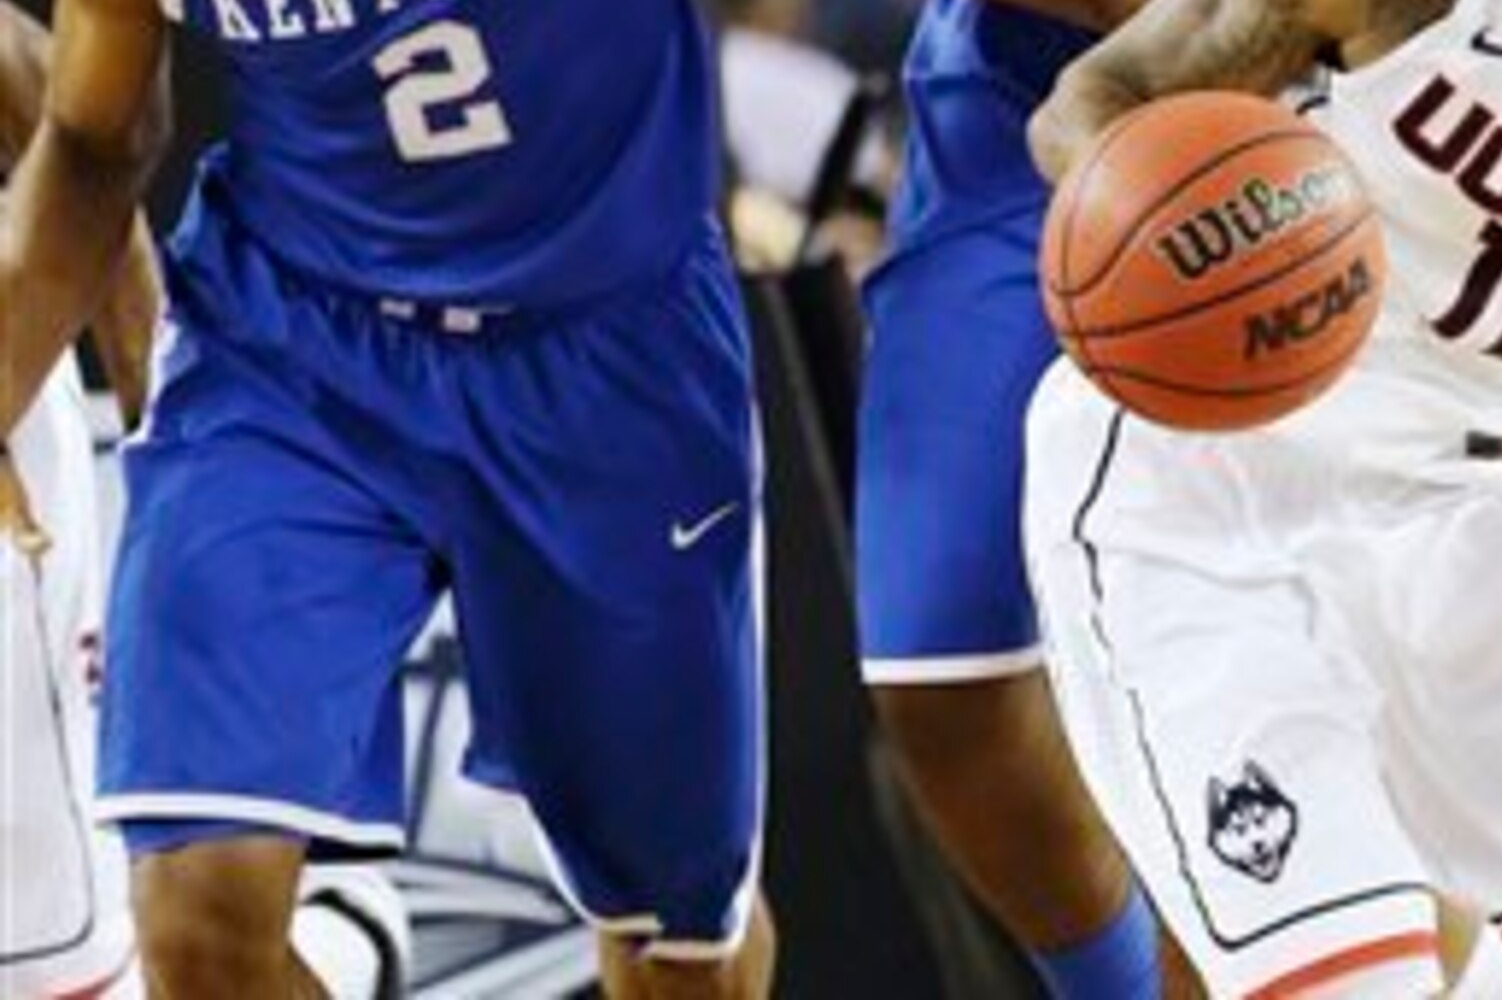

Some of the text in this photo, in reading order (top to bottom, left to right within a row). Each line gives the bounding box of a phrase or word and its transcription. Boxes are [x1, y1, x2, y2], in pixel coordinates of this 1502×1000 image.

[374, 21, 512, 162] 2
[1157, 170, 1350, 280] Wilso
[1241, 257, 1371, 362] NCAA
